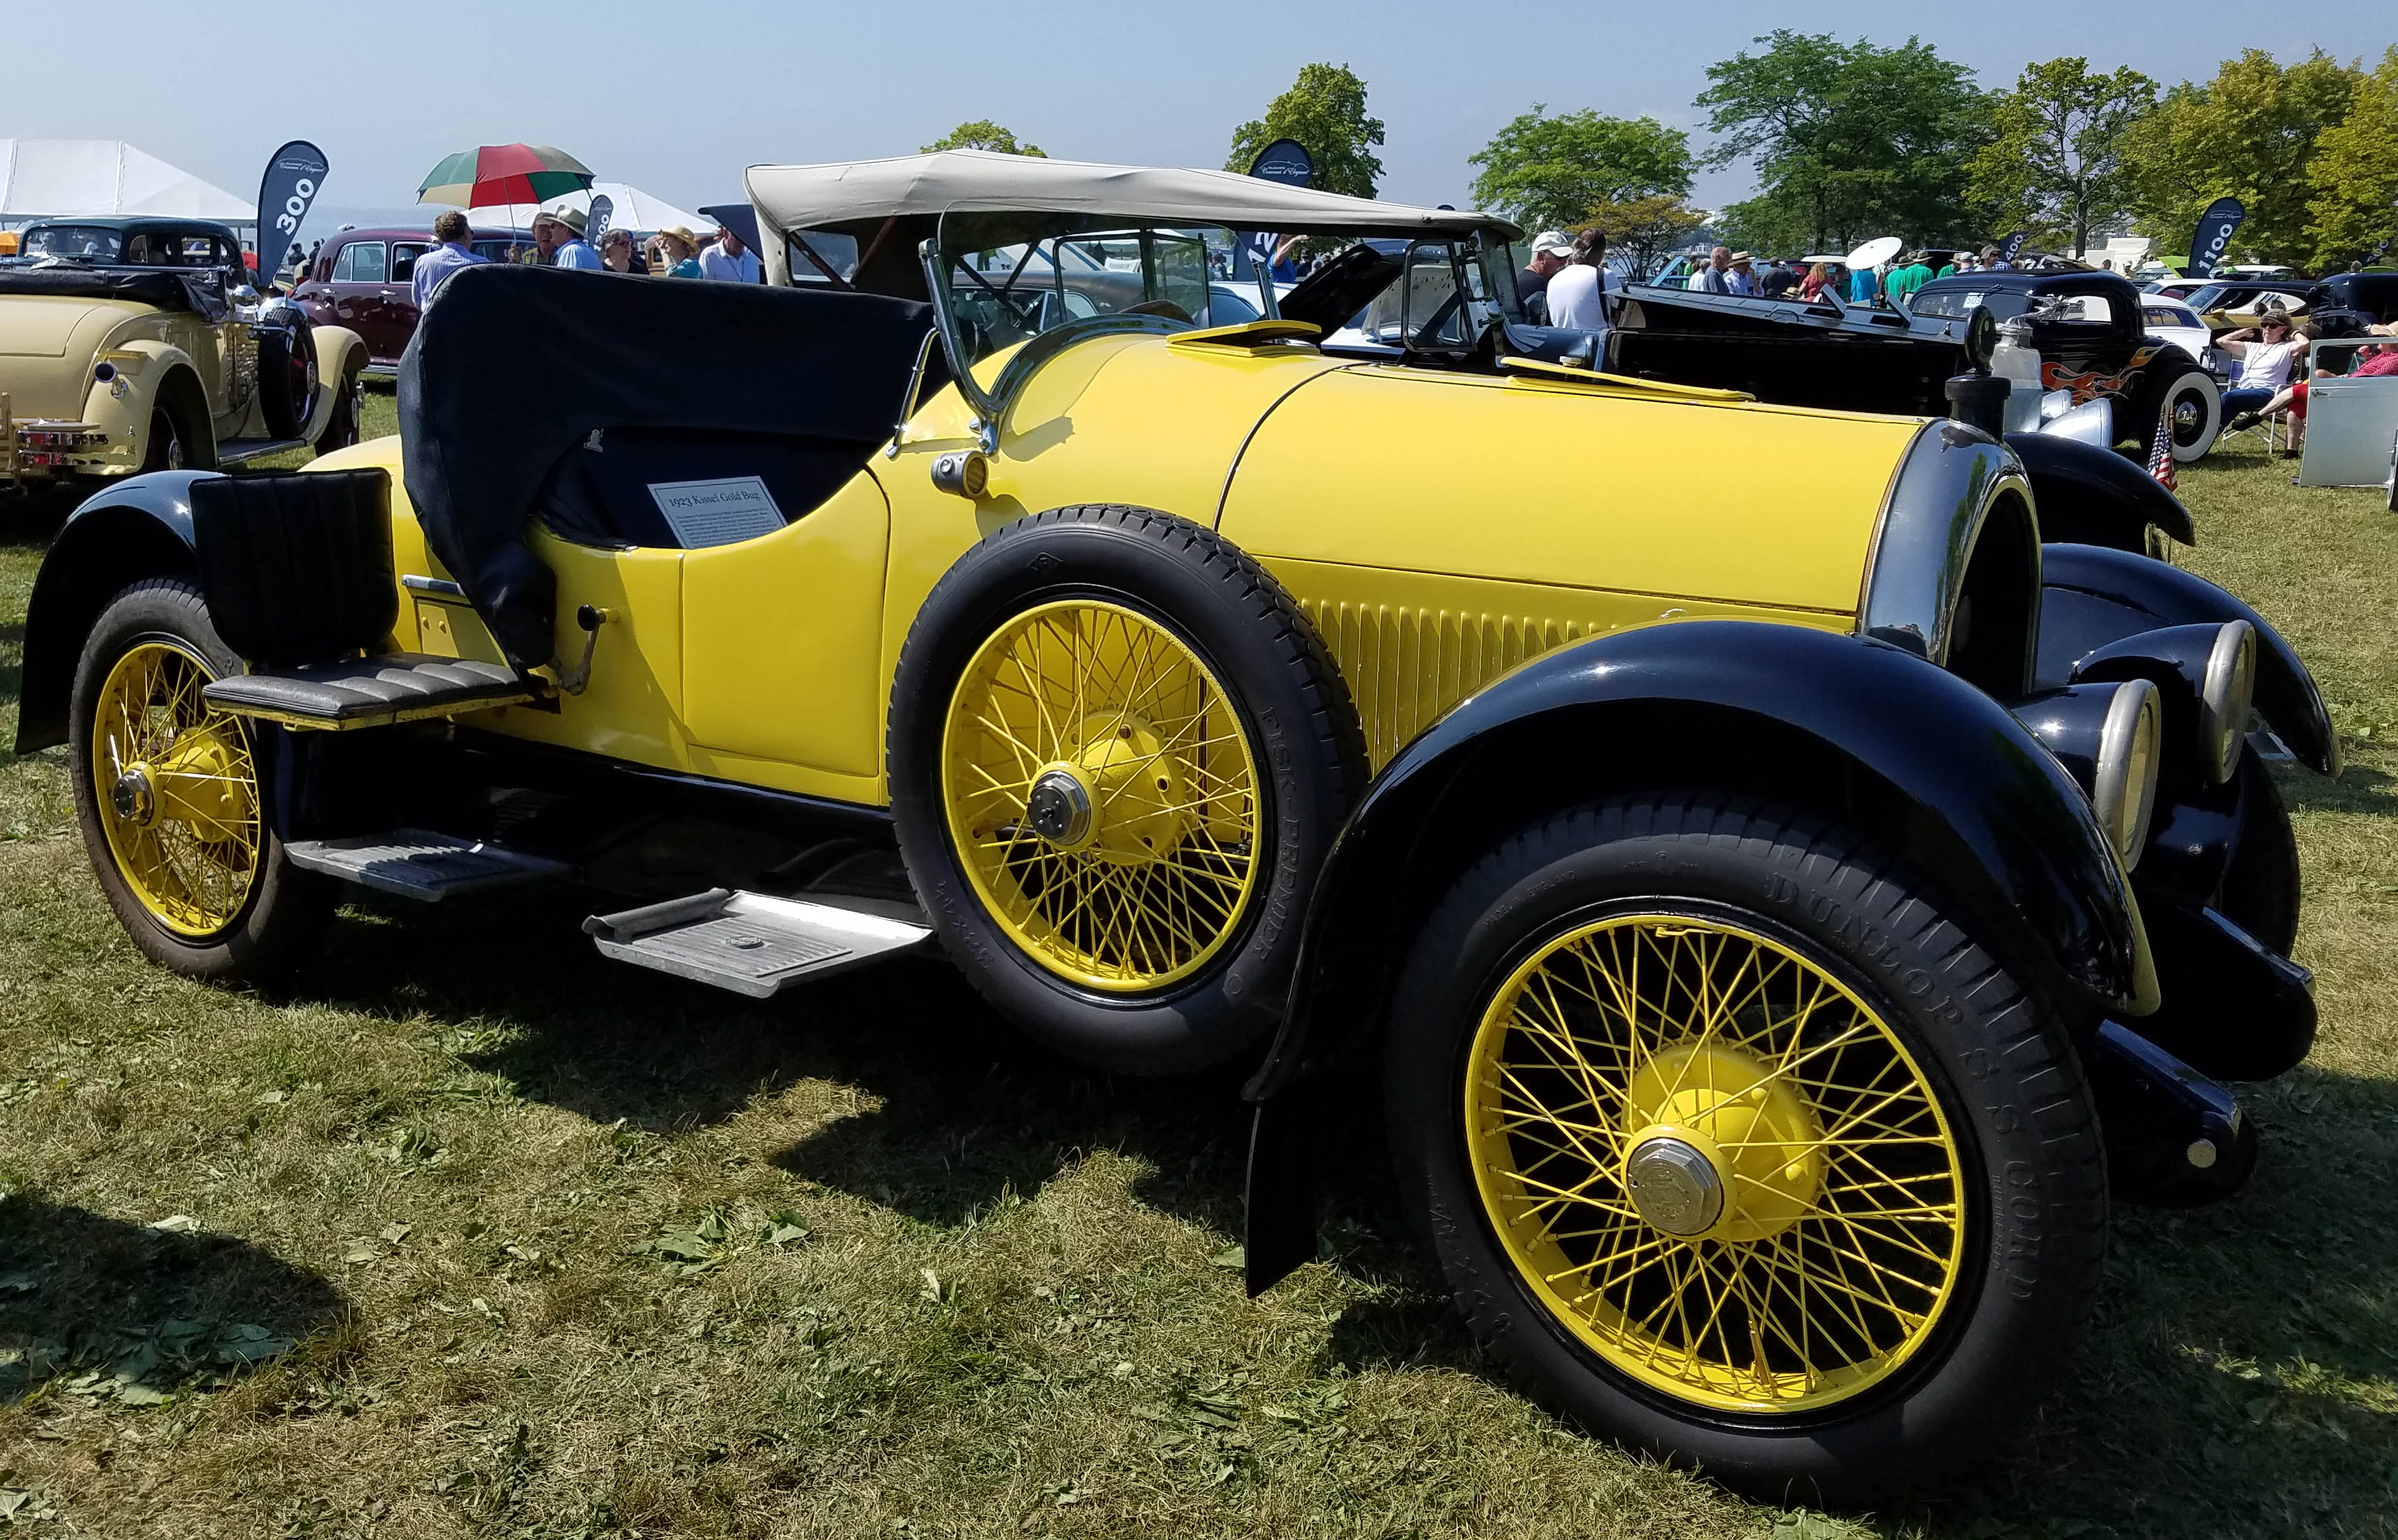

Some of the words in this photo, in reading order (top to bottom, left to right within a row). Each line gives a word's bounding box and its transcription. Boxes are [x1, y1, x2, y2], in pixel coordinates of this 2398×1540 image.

[276, 178, 314, 236] 300
[2006, 234, 2023, 261] 400
[2198, 224, 2233, 270] 1100
[668, 497, 693, 508] 1923
[691, 493, 720, 504] Kissel
[719, 492, 742, 501] Gold
[740, 490, 761, 501] Bug
[1765, 869, 1965, 1026] DUNLOP
[2003, 1160, 2043, 1299] CORD
